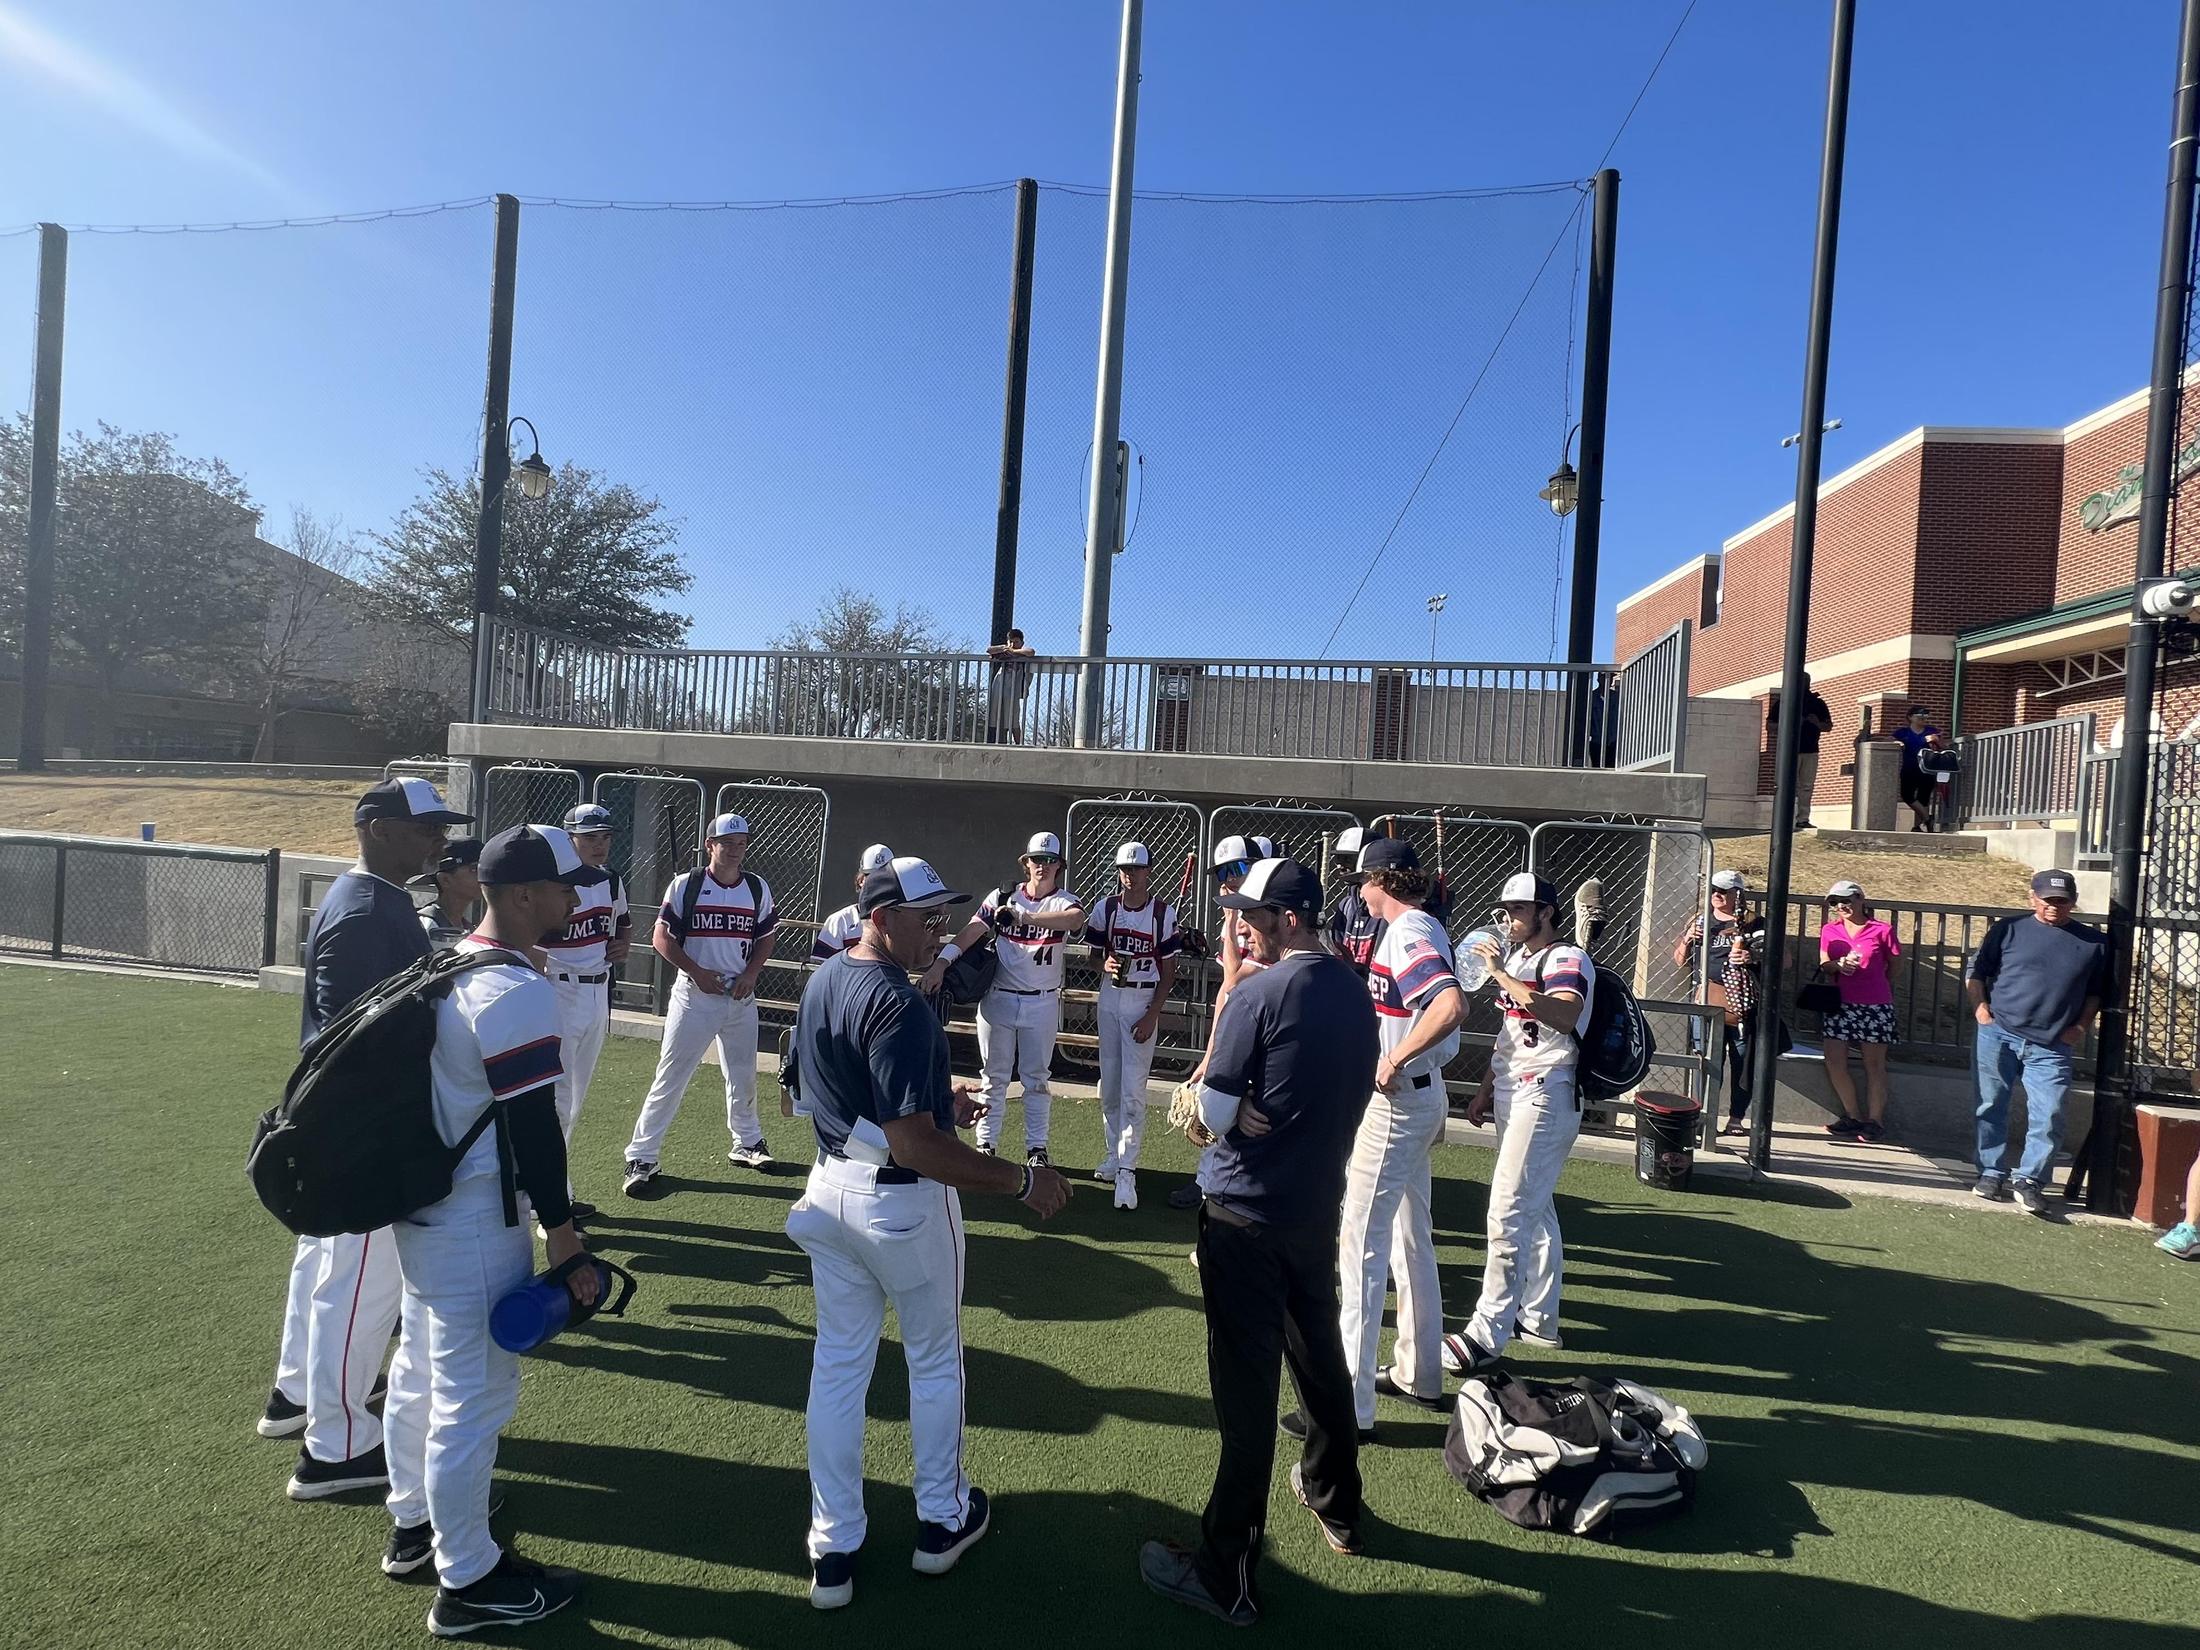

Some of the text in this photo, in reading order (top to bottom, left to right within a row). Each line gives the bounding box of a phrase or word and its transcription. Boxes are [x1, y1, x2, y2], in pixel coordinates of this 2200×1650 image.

[692, 913, 723, 929] UME
[1033, 946, 1054, 966] 44
[1523, 1021, 1539, 1048] 3
